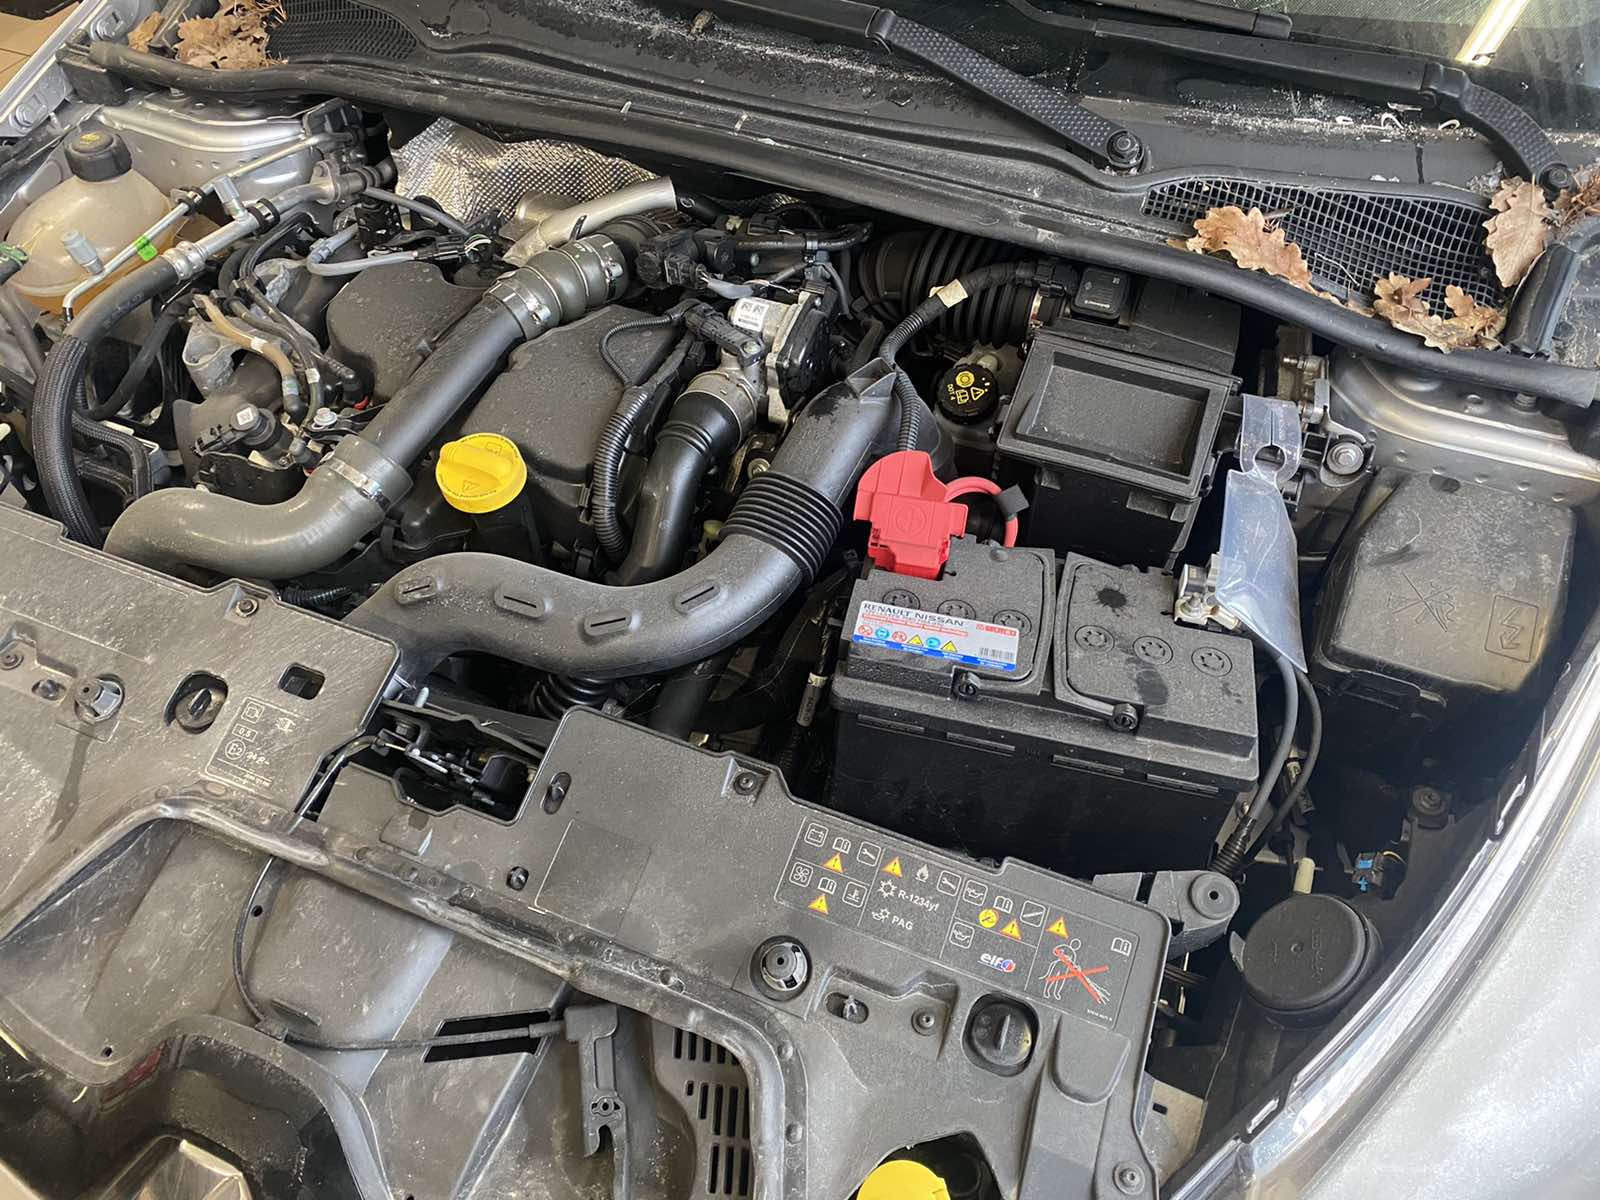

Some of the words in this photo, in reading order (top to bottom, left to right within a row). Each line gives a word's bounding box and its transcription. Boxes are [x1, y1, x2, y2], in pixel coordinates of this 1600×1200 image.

[864, 603, 910, 617] RENAULT
[915, 613, 965, 627] NISSAN
[897, 888, 940, 912] R-1234yf
[891, 915, 914, 931] PAG
[980, 953, 1004, 969] elf
